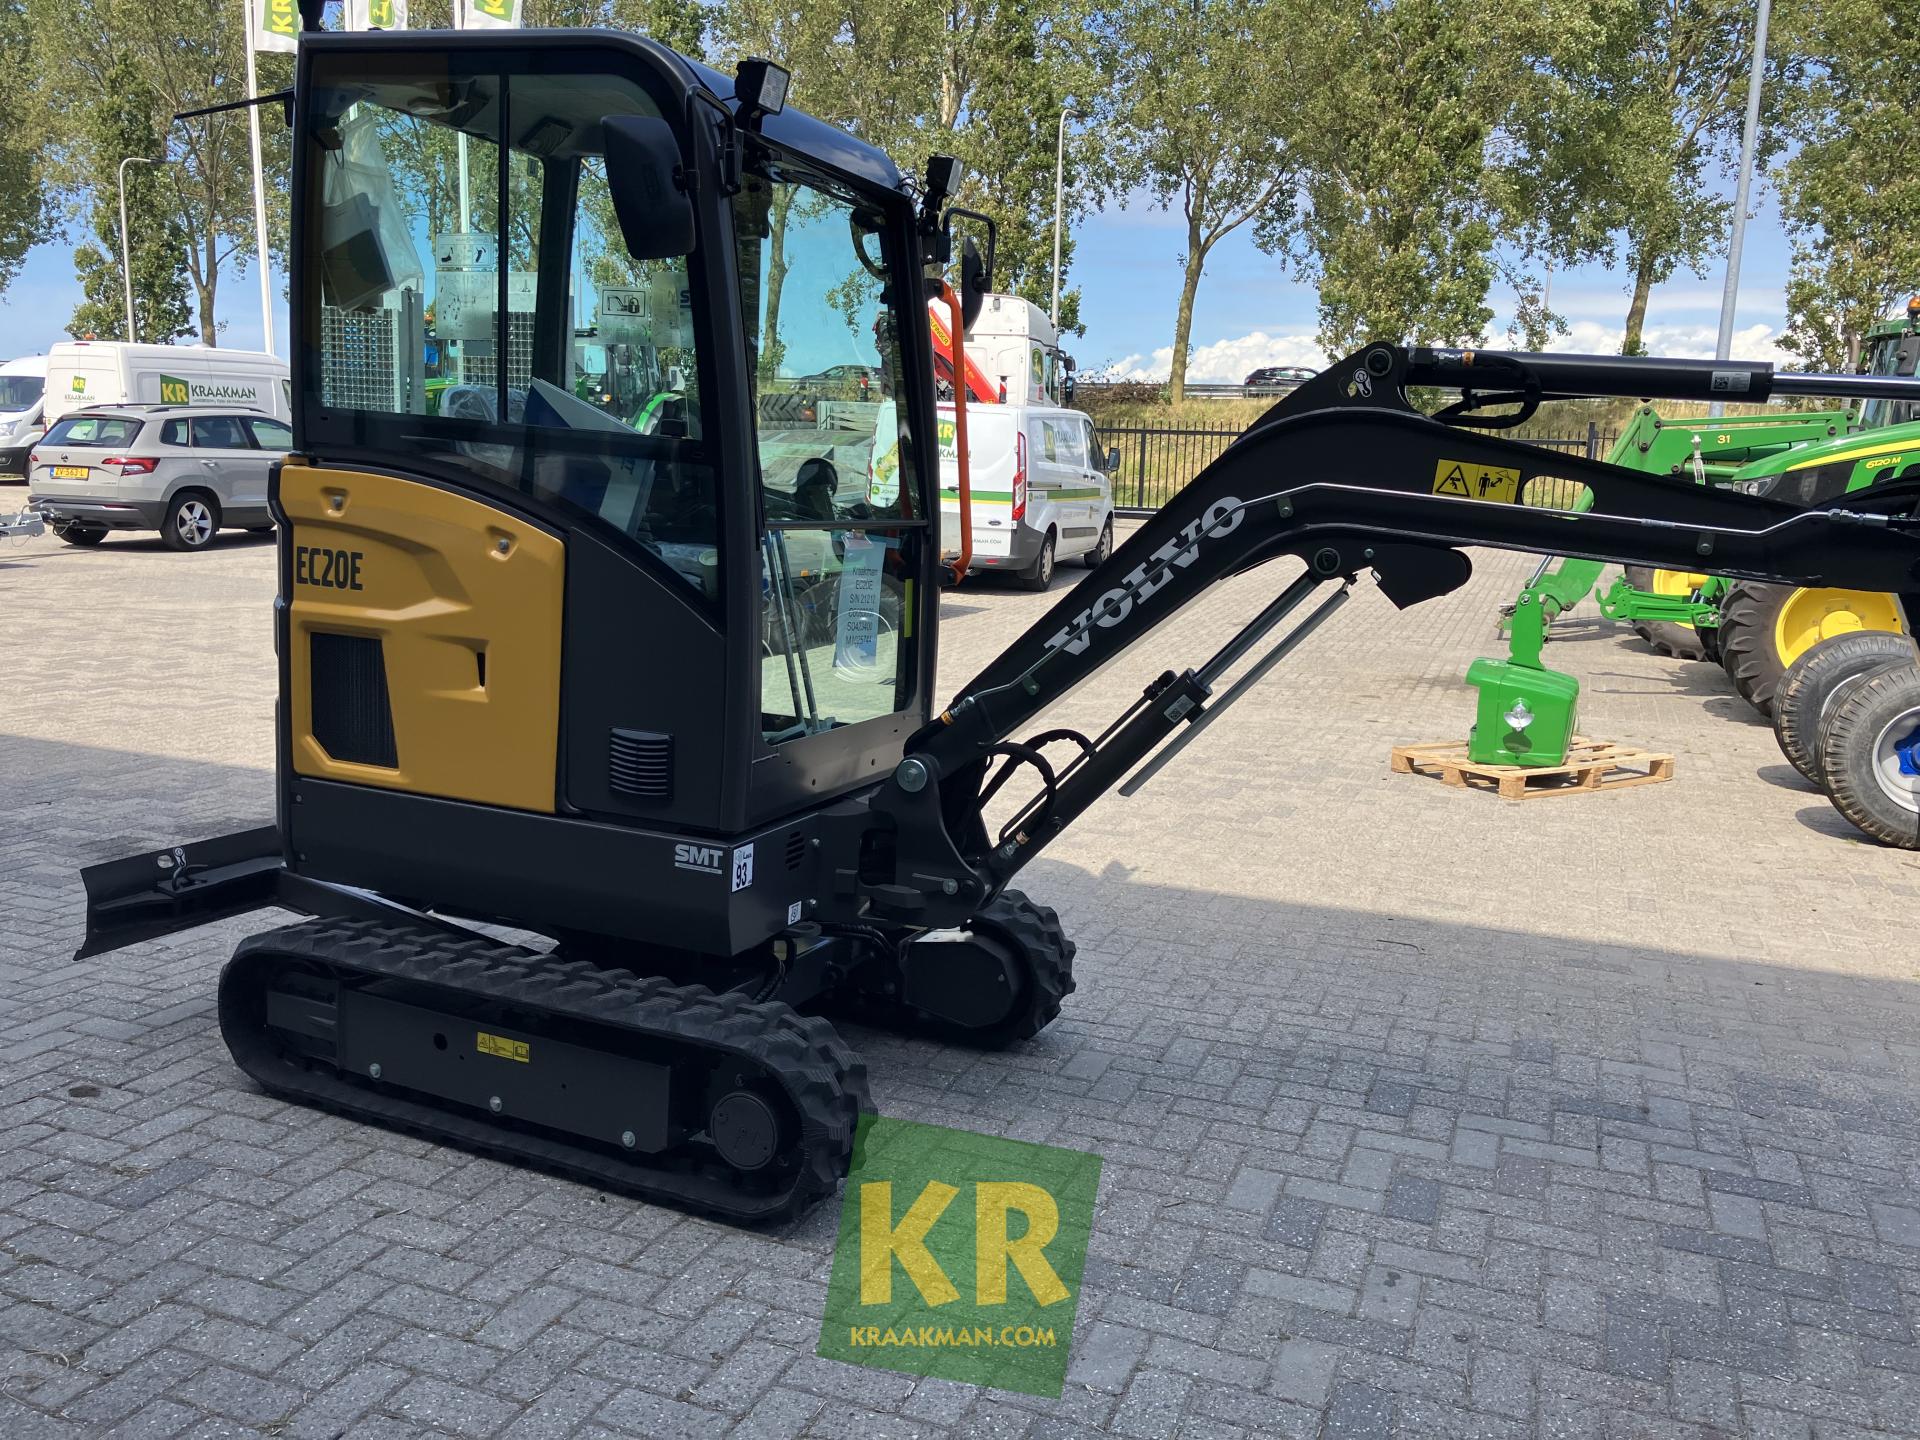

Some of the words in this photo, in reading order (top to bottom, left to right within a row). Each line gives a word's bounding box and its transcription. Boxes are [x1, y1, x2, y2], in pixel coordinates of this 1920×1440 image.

[73, 379, 86, 389] KR
[161, 383, 189, 402] KR
[190, 384, 257, 399] KRAAKMAN
[1717, 434, 1731, 444] 31
[1865, 458, 1891, 470] 6120
[1892, 456, 1902, 464] M
[296, 546, 364, 591] EC20E
[1043, 496, 1246, 655] VOLVO
[674, 844, 724, 868] SMT
[736, 862, 748, 889] 93
